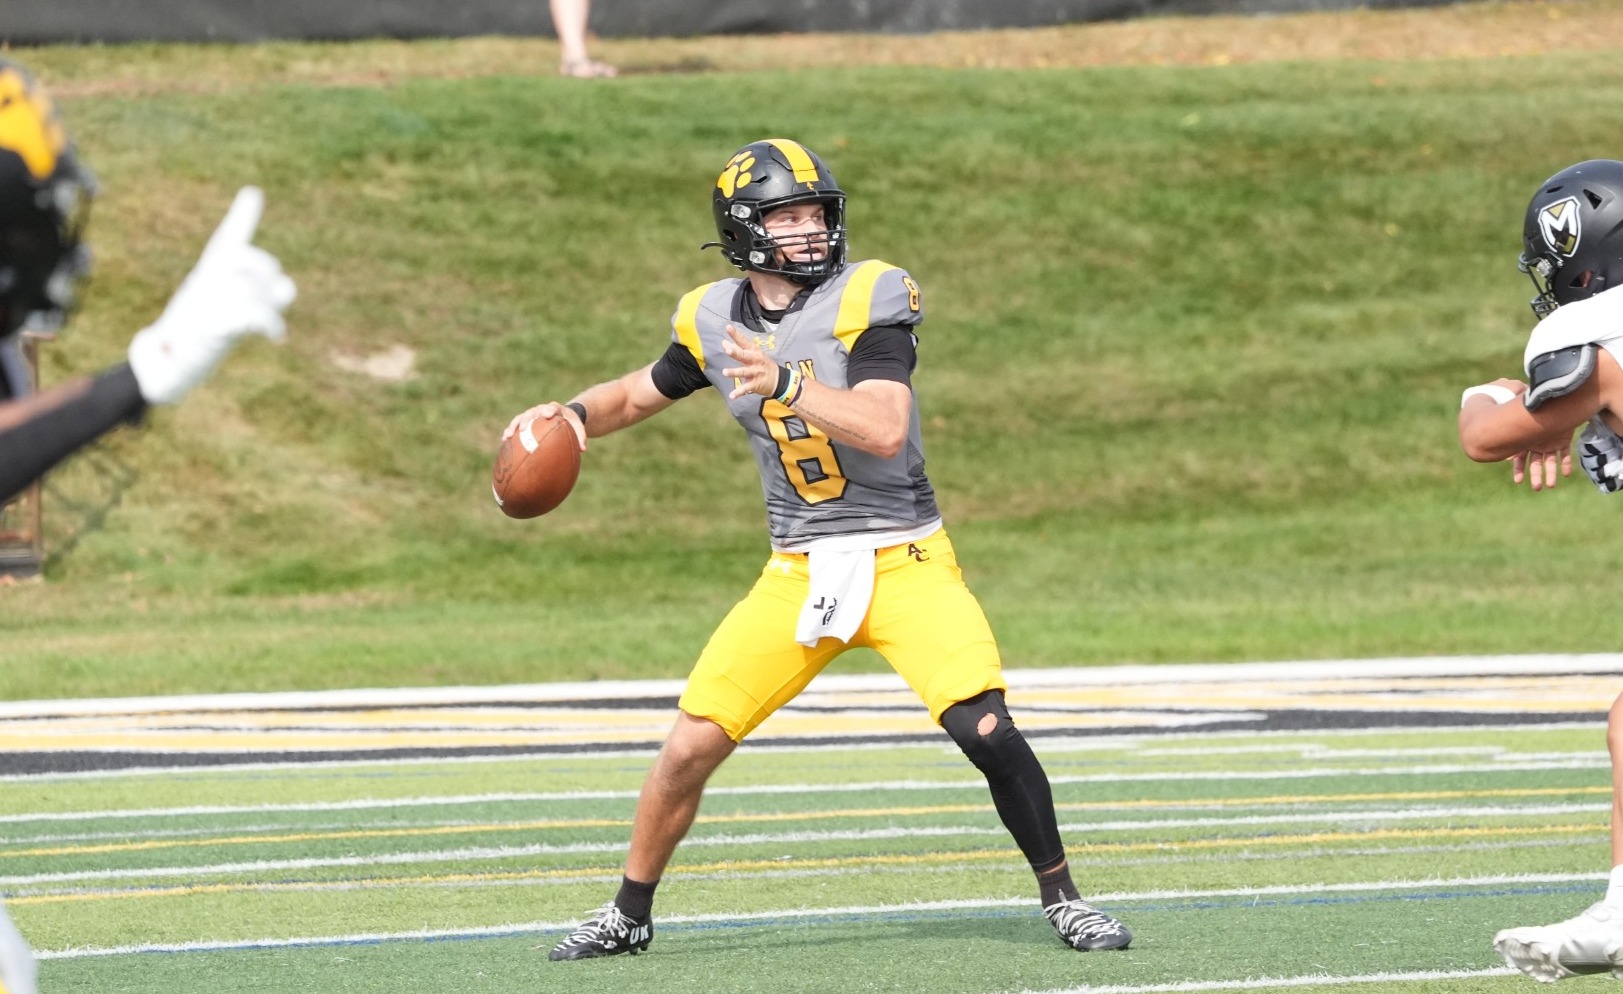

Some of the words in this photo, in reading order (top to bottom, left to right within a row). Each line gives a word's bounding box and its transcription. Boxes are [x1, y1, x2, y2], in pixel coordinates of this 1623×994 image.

[1541, 200, 1577, 246] M
[902, 276, 920, 313] 8
[759, 397, 849, 507] 8
[630, 924, 649, 945] UK
